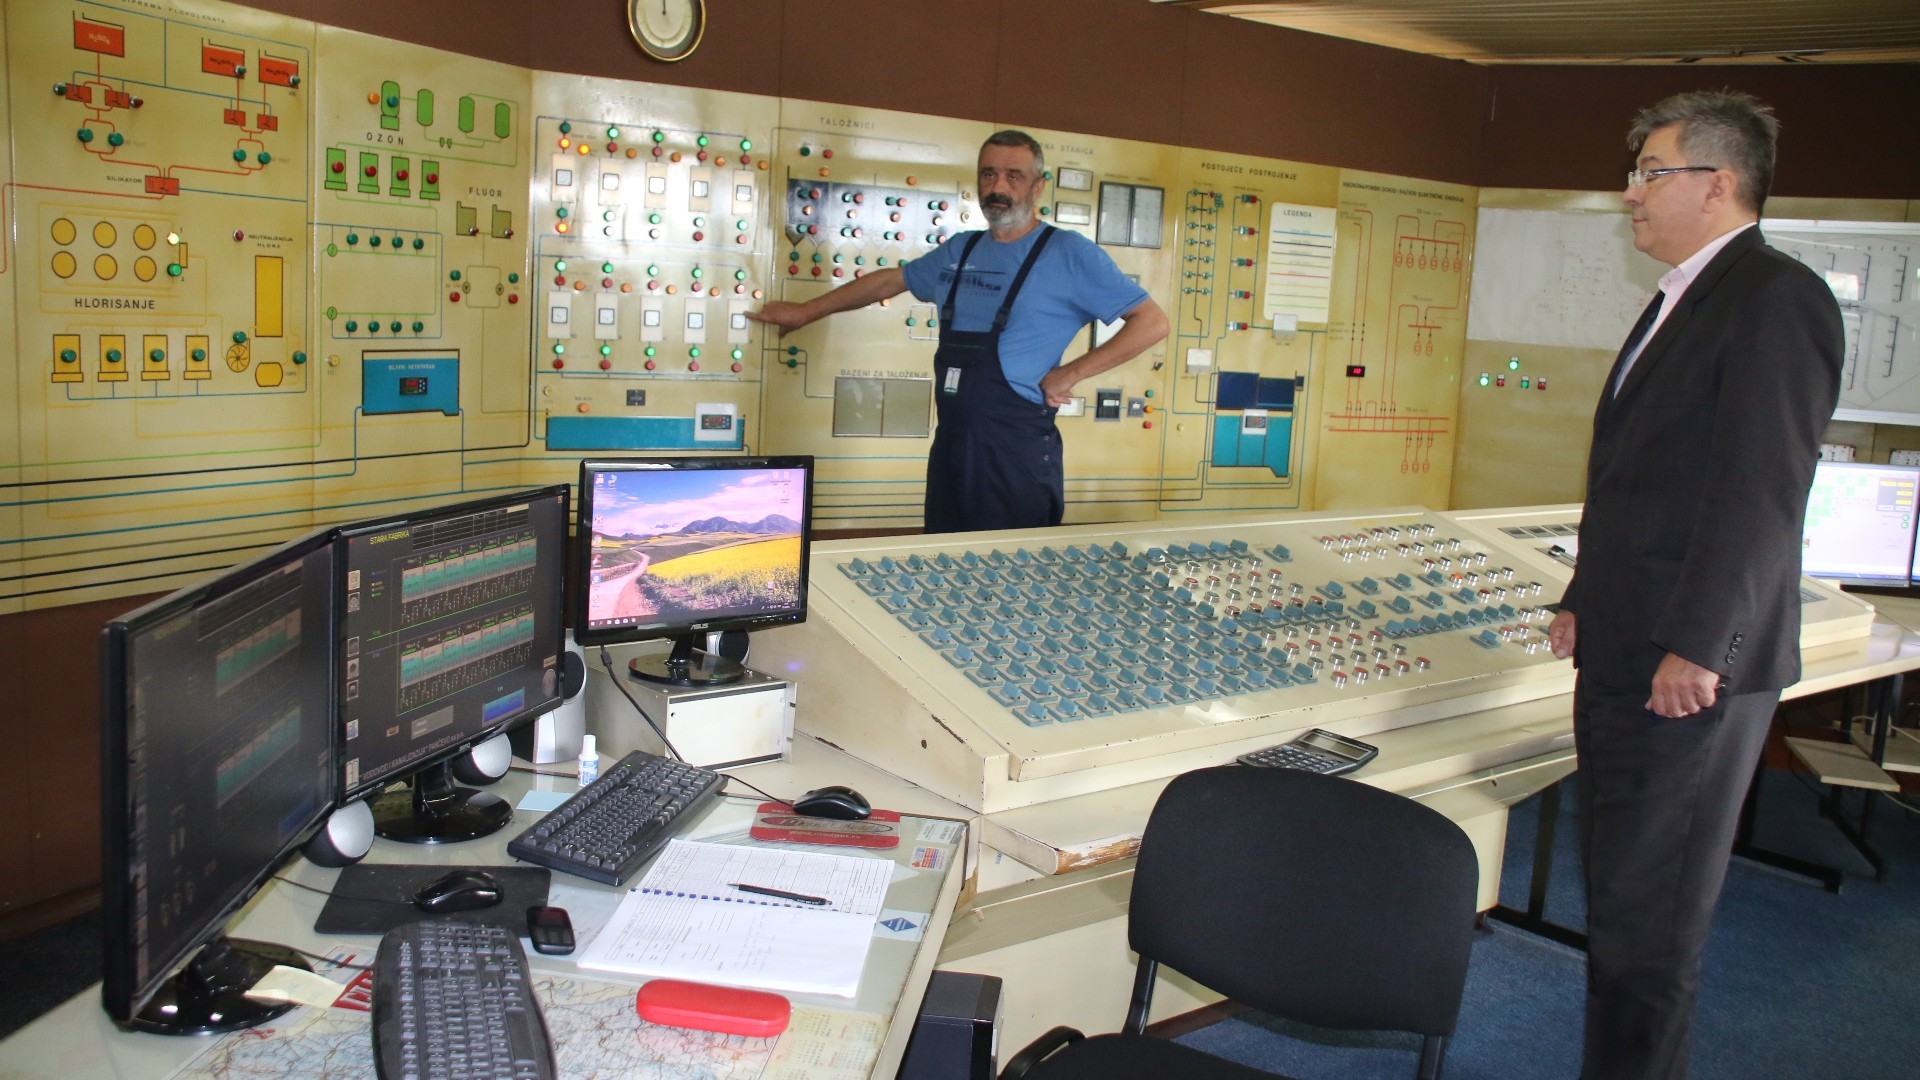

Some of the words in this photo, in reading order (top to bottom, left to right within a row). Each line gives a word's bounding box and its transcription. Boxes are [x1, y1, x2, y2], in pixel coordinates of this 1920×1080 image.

[819, 116, 875, 130] TALOŽNICI
[366, 131, 404, 145] OZON
[1059, 143, 1095, 156] STANICA
[106, 175, 143, 184] SILIKATOR
[1249, 168, 1298, 181] POSTROJENJE
[468, 186, 503, 197] FLUOR
[1283, 208, 1313, 219] LEGENDA
[74, 297, 156, 310] HLORISANJE
[840, 368, 871, 377] BAZENI
[370, 534, 388, 545] STARA
[388, 529, 410, 541] FABRIKA
